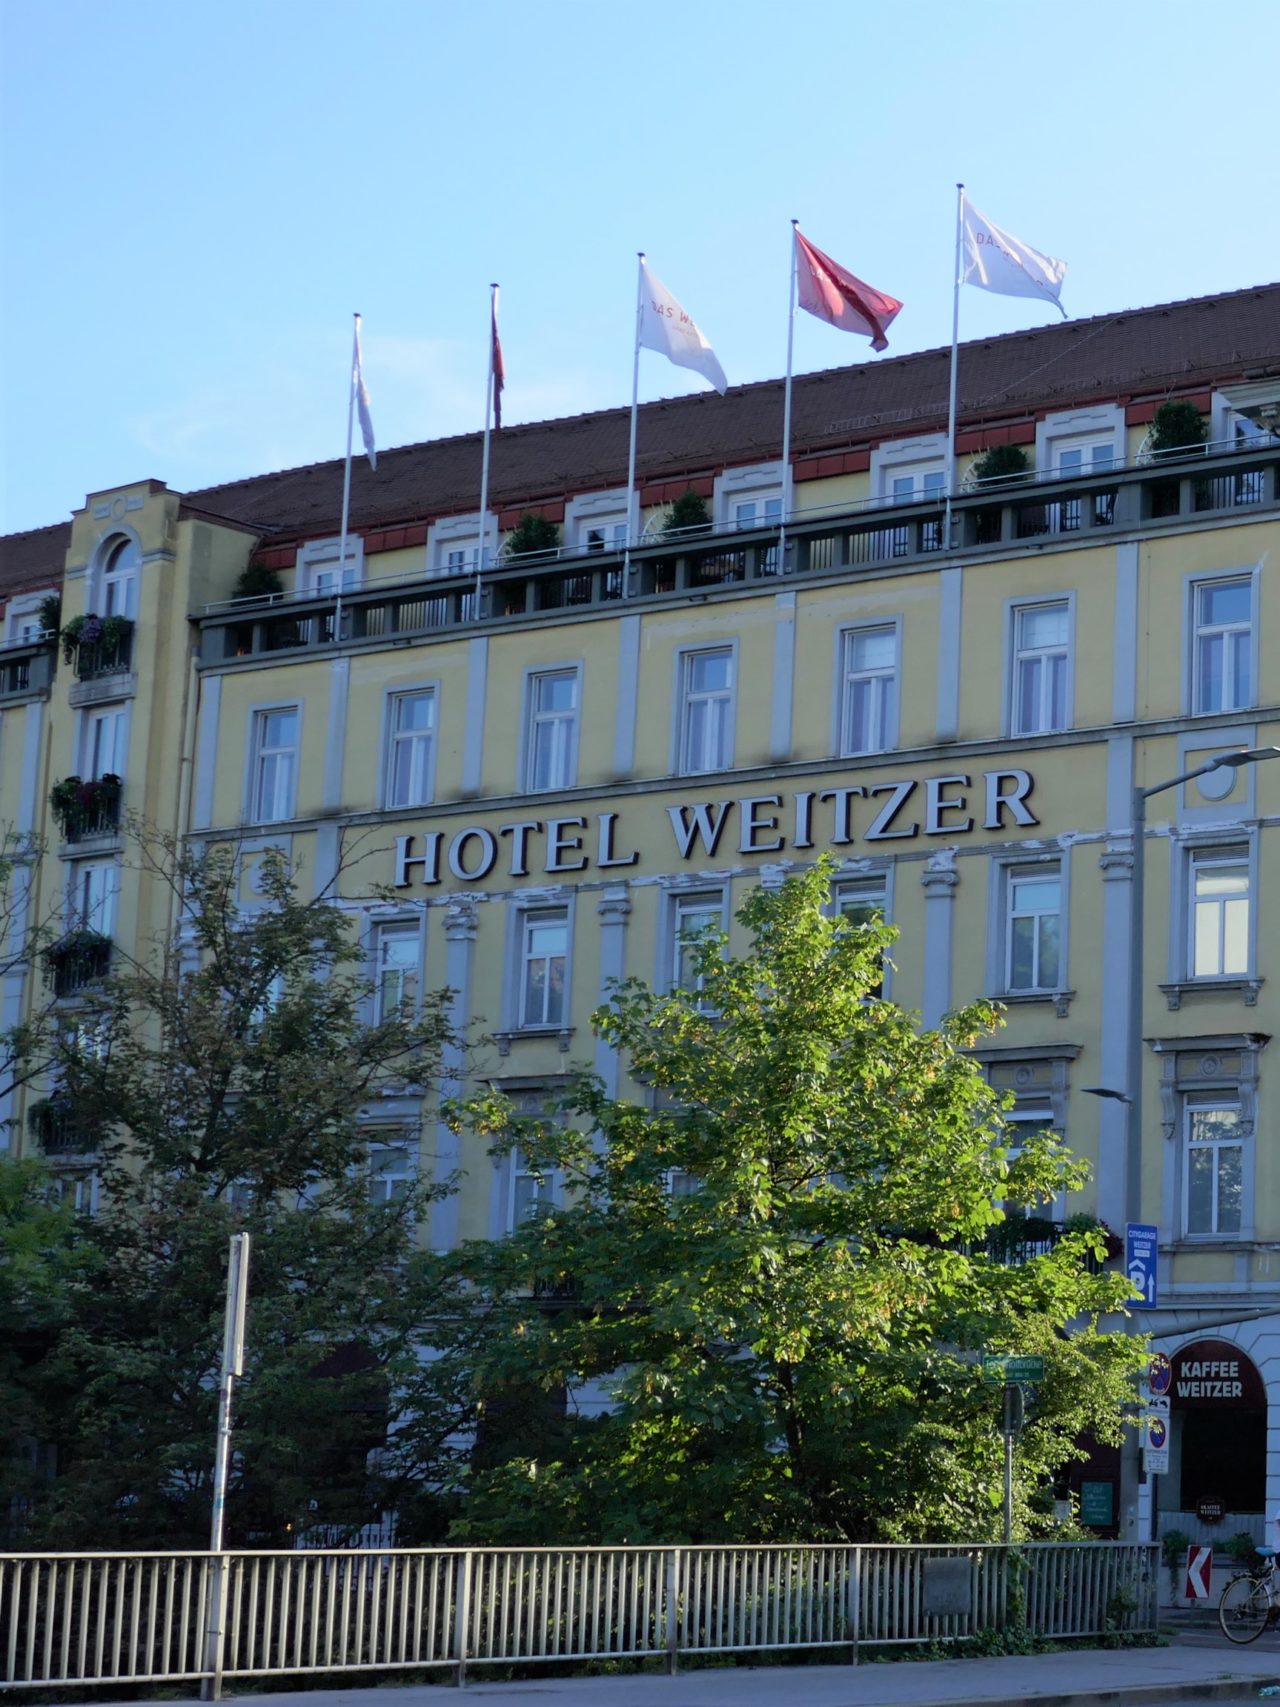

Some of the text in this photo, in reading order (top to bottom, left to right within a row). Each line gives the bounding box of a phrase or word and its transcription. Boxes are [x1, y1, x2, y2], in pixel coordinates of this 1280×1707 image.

[393, 769, 1040, 887] HOTEL WEITZER
[1181, 1361, 1239, 1377] KAFFEE
[1176, 1381, 1243, 1398] WEITZER
